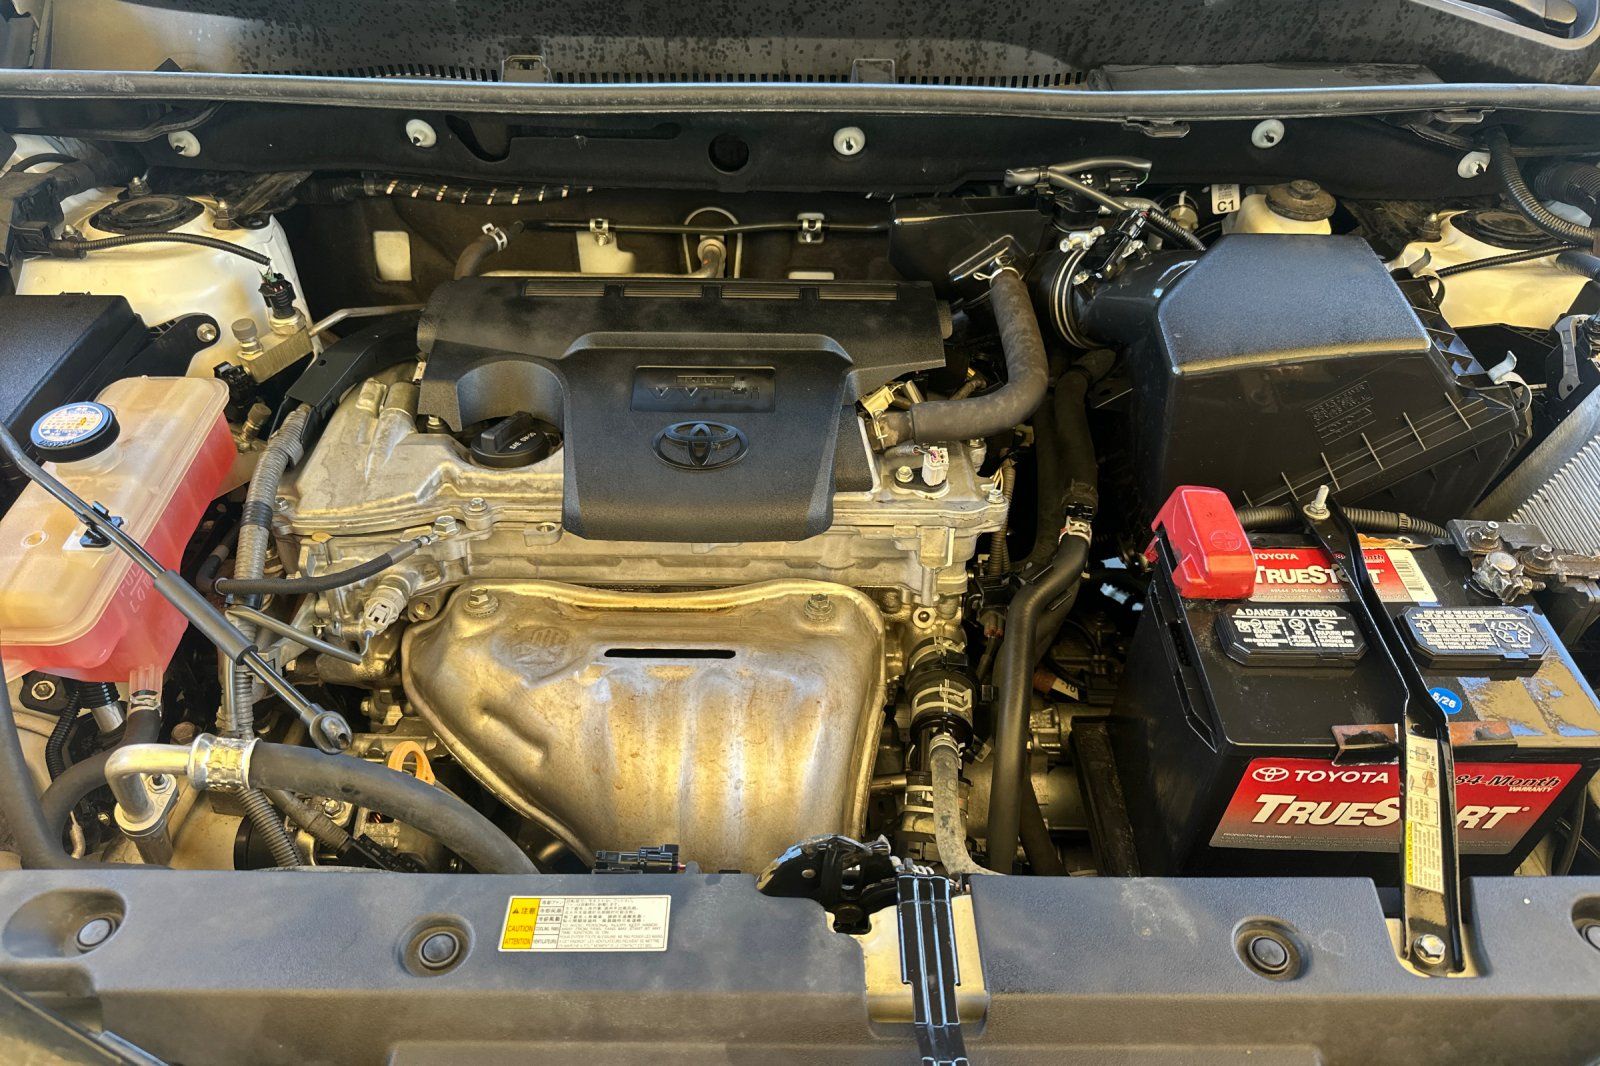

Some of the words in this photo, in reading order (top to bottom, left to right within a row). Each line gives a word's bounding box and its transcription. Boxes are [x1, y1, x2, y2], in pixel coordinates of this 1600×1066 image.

[1217, 199, 1235, 212] C1
[1254, 552, 1299, 561] TOYOTA
[1244, 607, 1289, 617] DANGER
[1299, 608, 1338, 618] POISON
[1294, 769, 1390, 784] TOYOTA
